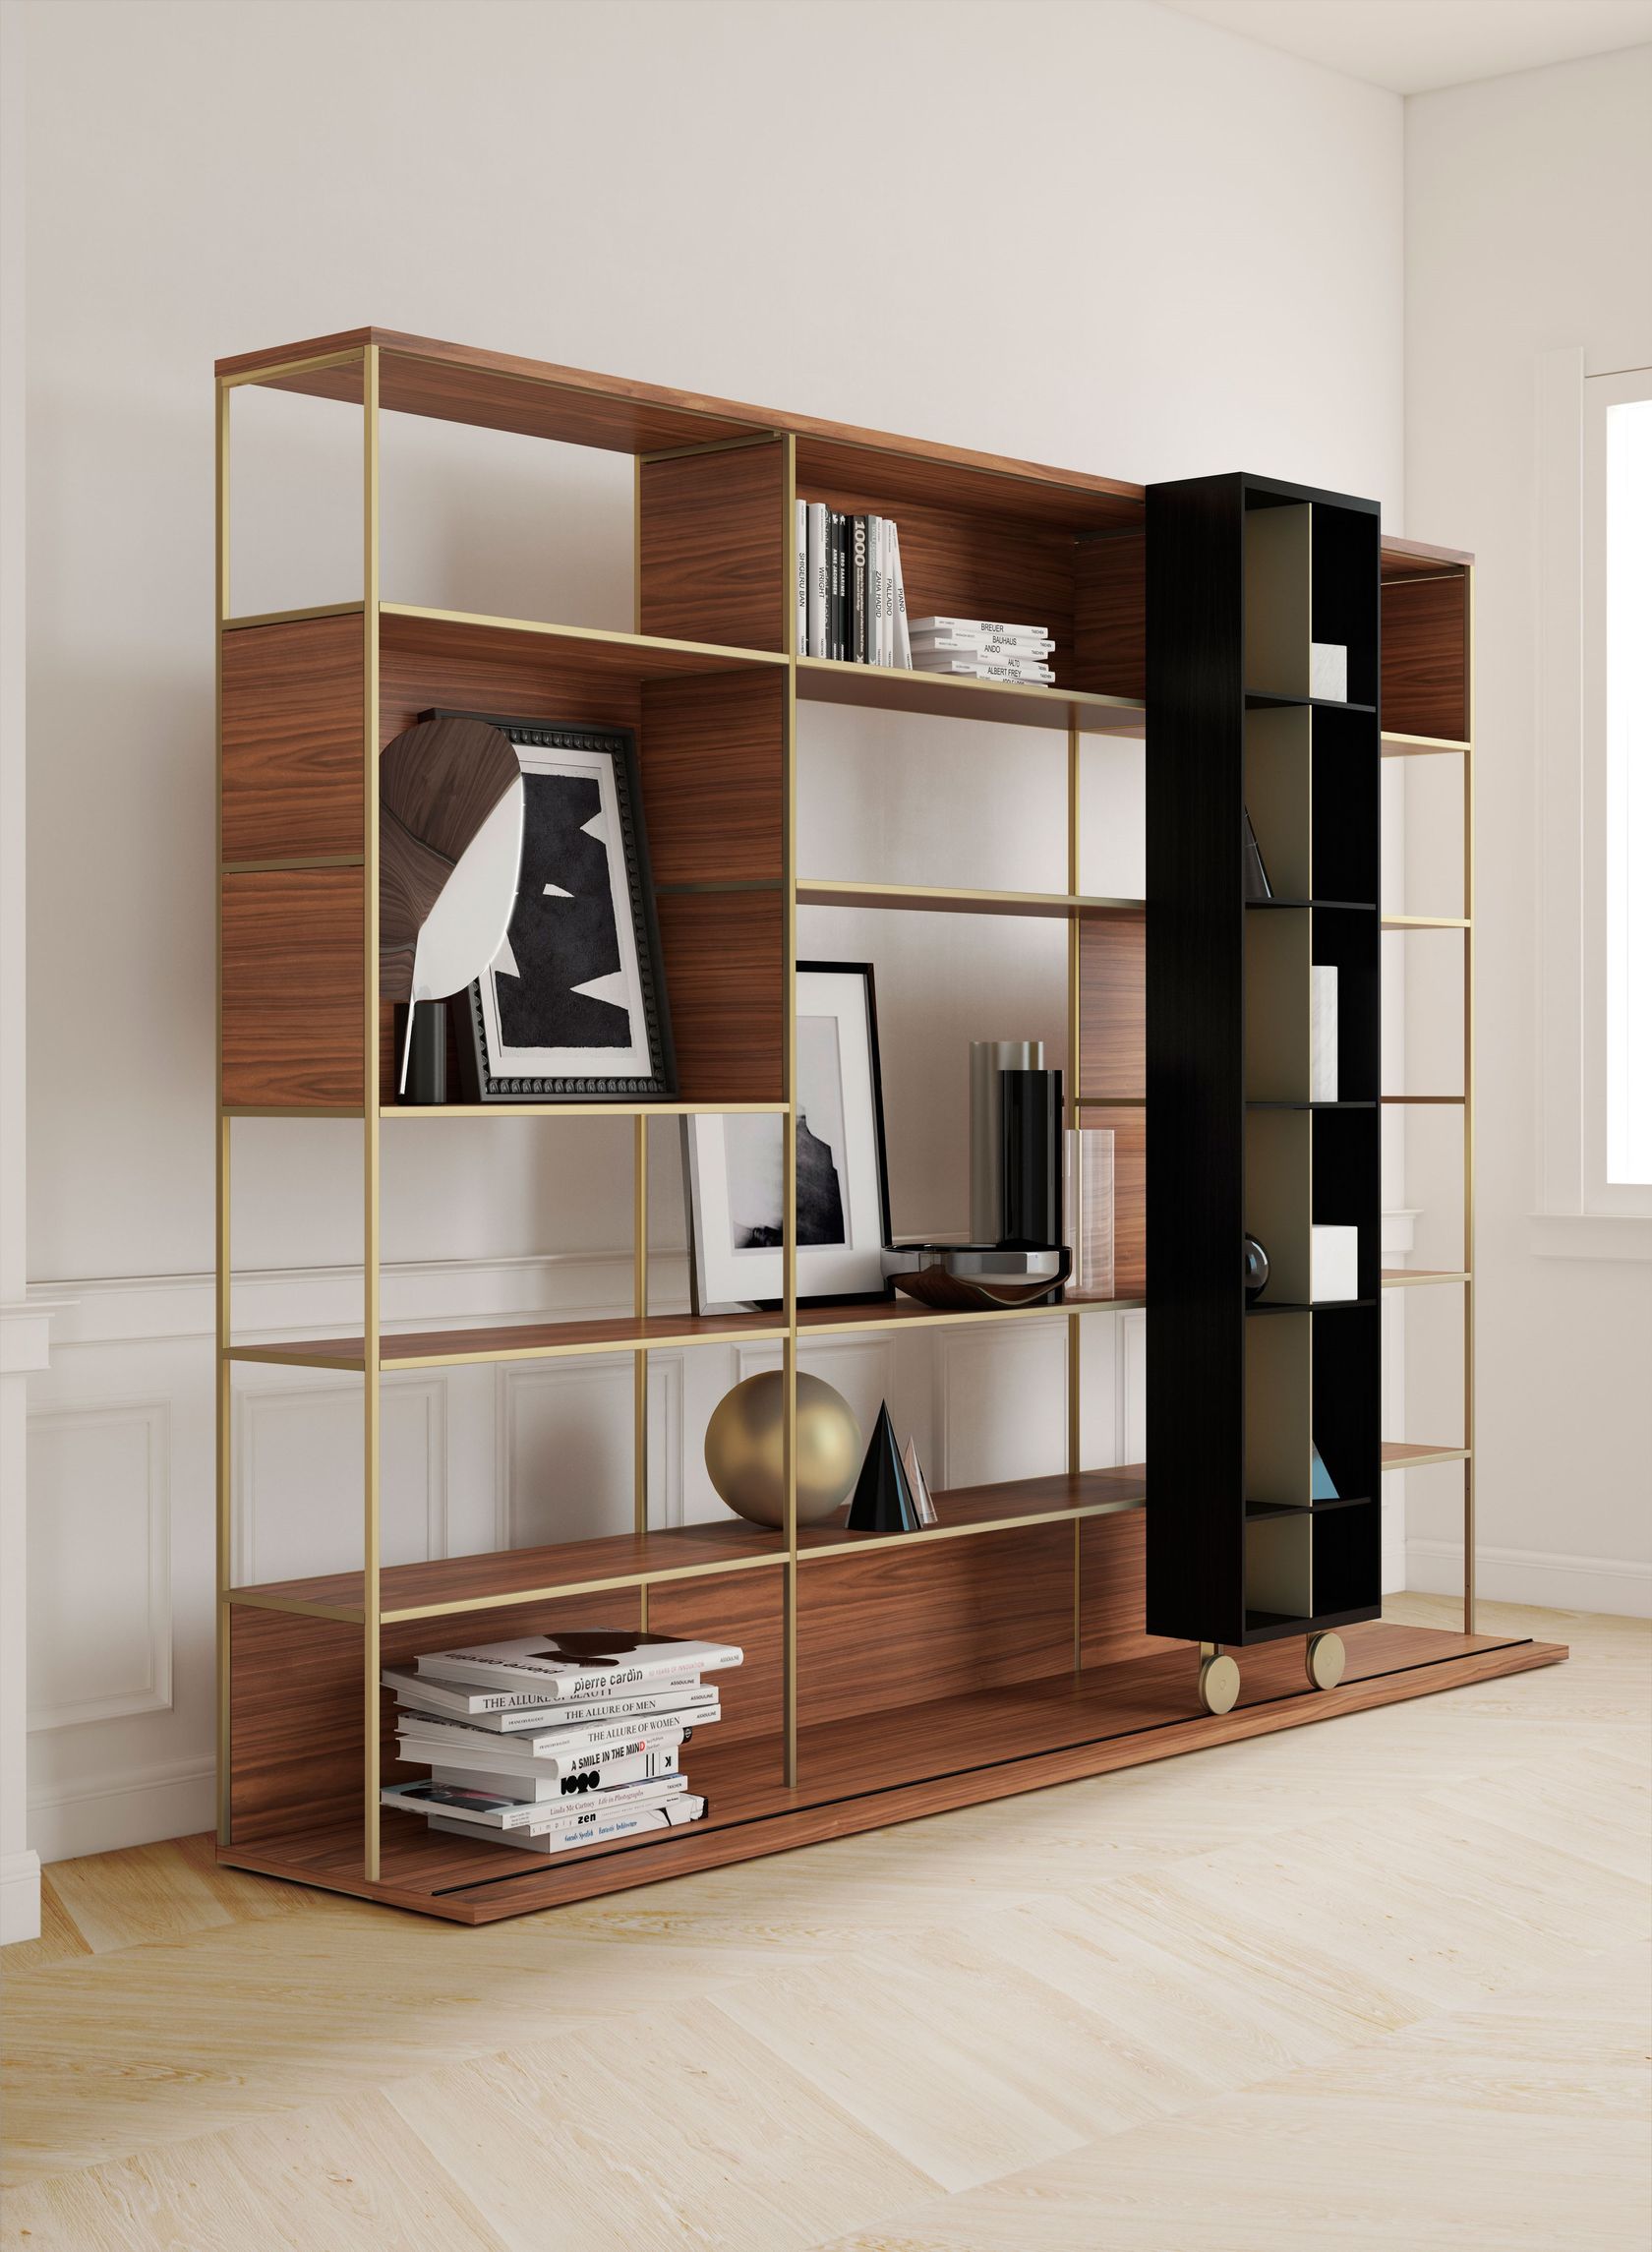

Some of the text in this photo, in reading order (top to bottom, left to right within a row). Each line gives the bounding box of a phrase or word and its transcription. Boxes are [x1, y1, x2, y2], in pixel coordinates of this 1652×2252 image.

[855, 521, 865, 567] 1000
[981, 623, 1004, 632] BREUER
[992, 636, 1017, 646] BAUHAUS
[984, 645, 1000, 653] ANDO
[1008, 658, 1020, 667] AALTO
[988, 667, 1022, 678] ALBERT FREY
[574, 1675, 606, 1694] pierre
[610, 1668, 643, 1686] cardin
[483, 1698, 506, 1709] THE
[565, 1700, 656, 1720] THE ALLURE OF MEN
[588, 1717, 680, 1742] THE ALLURE OF WOMEN
[571, 1761, 577, 1771] A
[578, 1755, 600, 1769] SMILE
[602, 1752, 610, 1762] IN
[612, 1748, 625, 1760] THE
[626, 1741, 645, 1755] MIND
[614, 1790, 643, 1802] Photographs
[578, 1813, 596, 1824] zen
